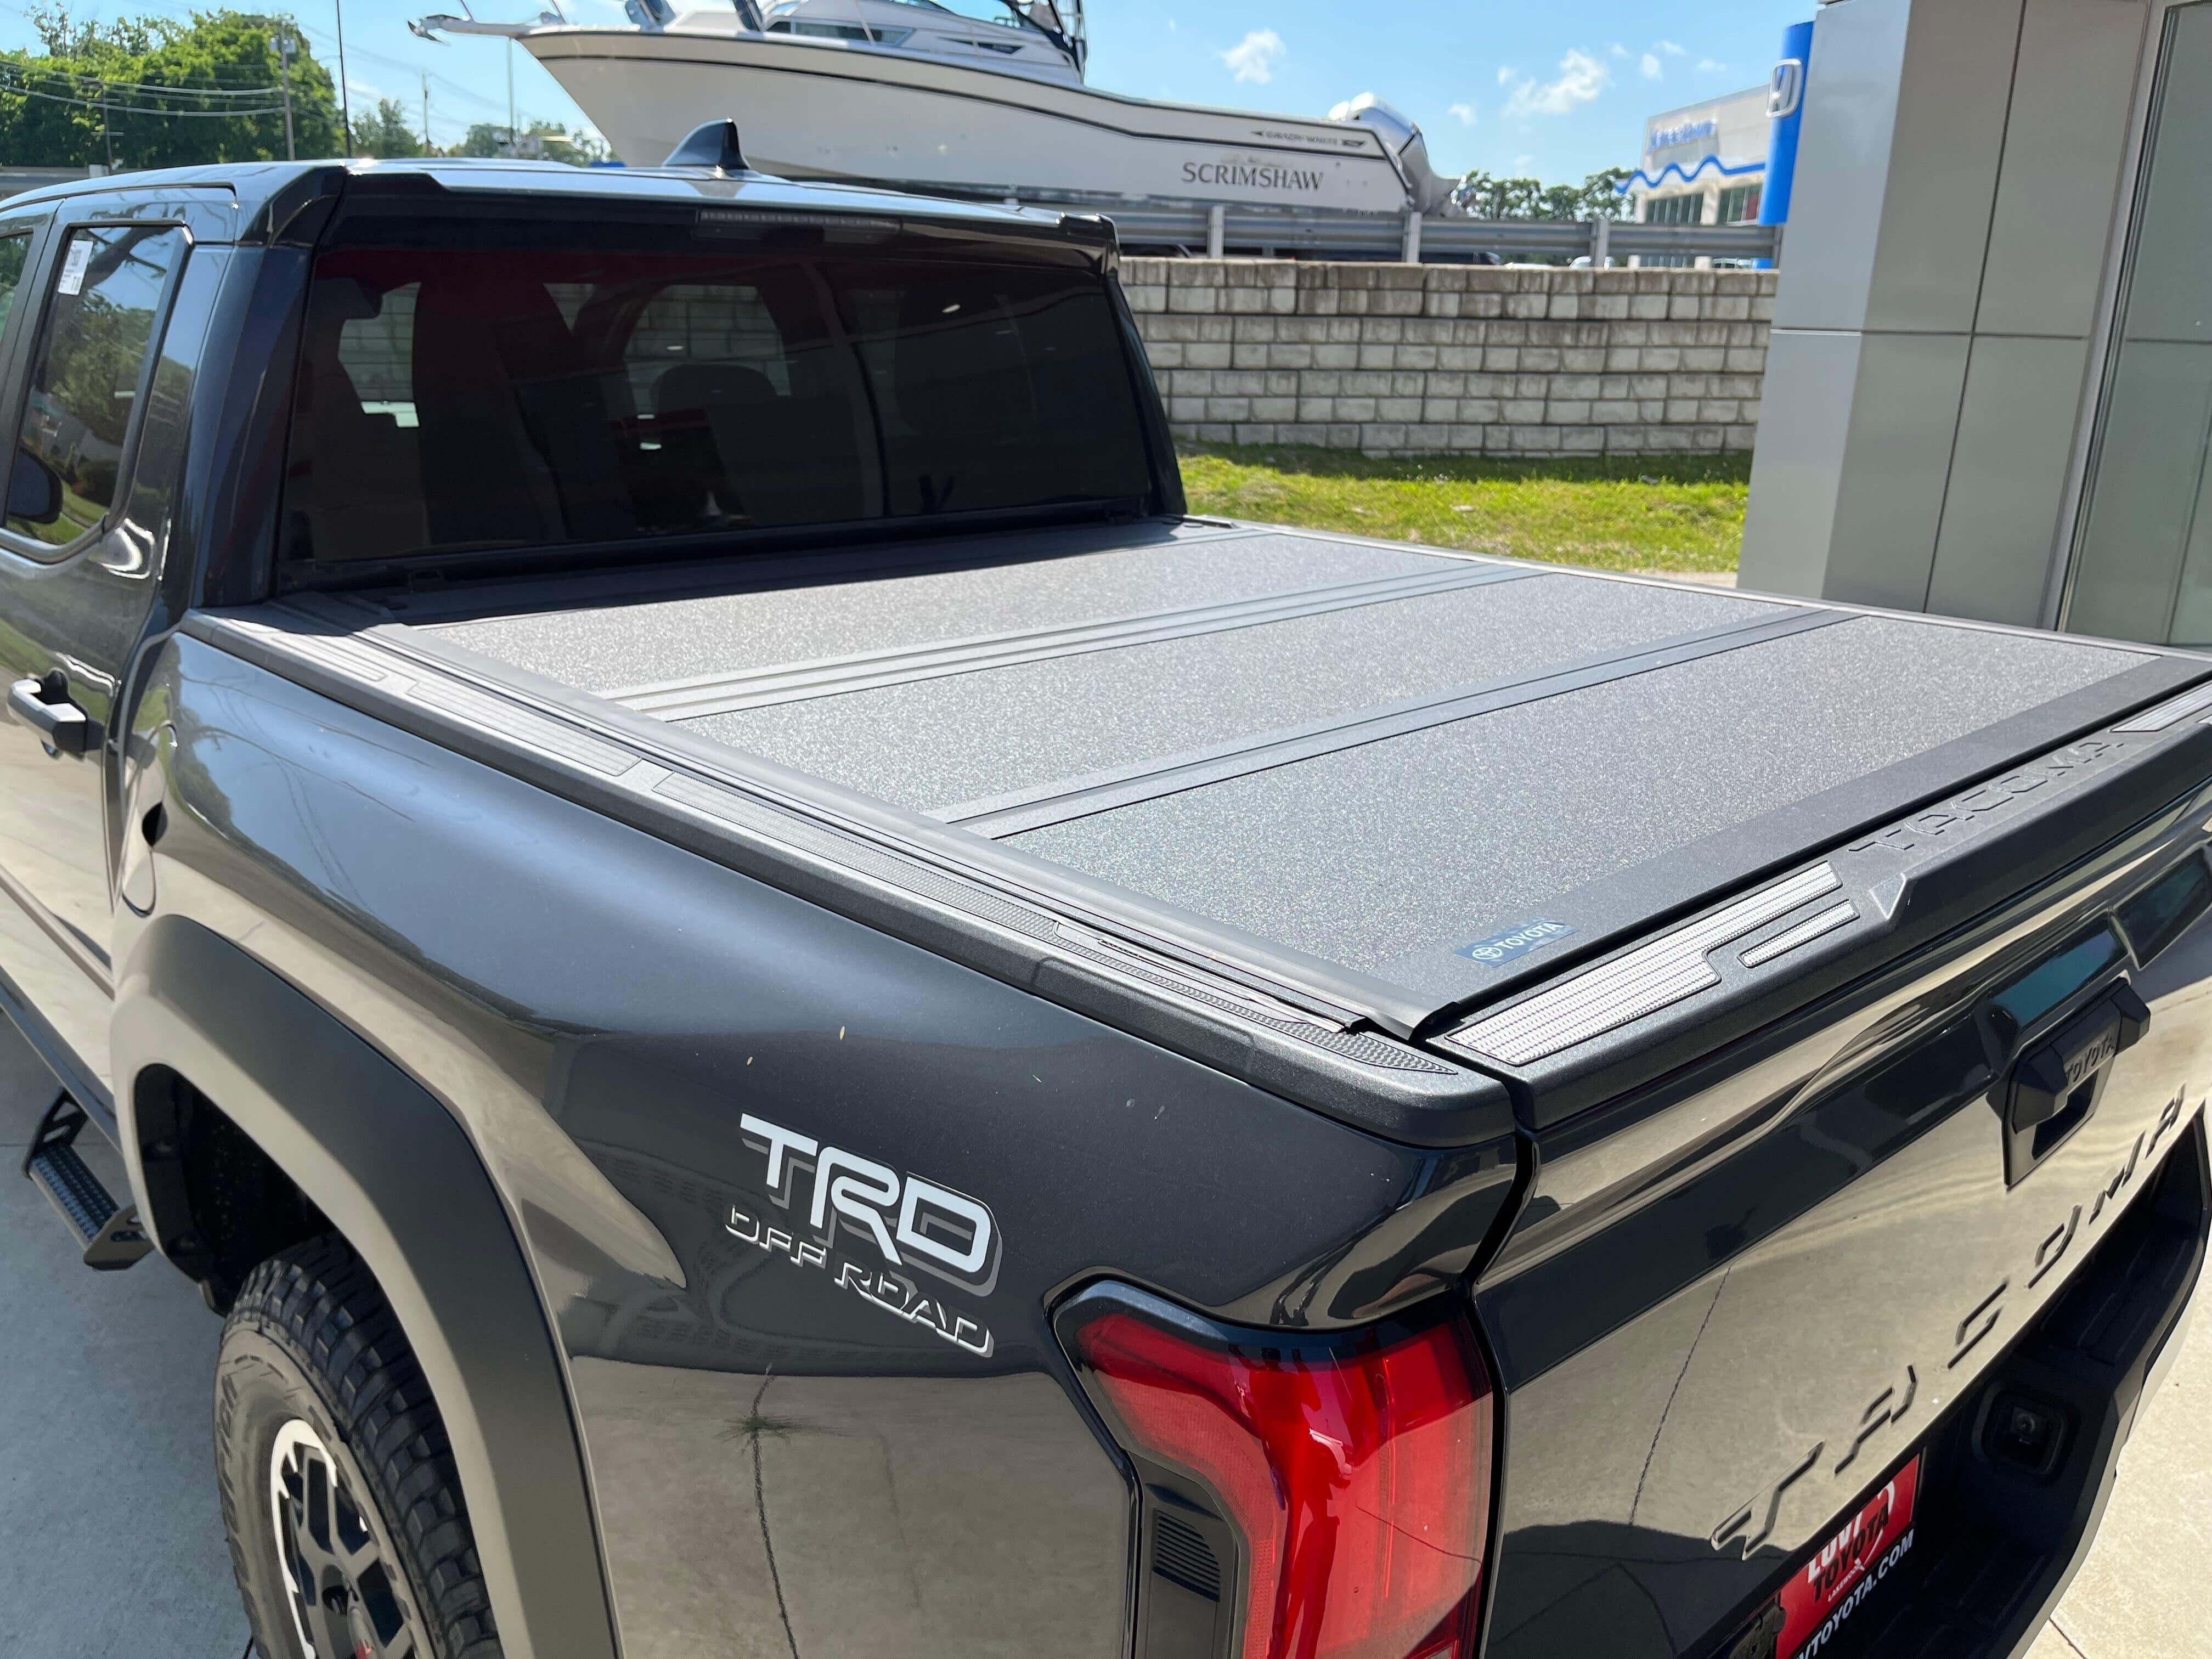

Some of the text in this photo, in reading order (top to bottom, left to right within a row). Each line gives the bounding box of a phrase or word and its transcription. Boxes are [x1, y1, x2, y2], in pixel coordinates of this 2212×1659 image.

[1181, 162, 1324, 190] SCRIMSHAW
[1847, 741, 2125, 851] TACOMA
[1493, 922, 1564, 950] TOYOTA
[2064, 1033, 2117, 1082] TOYOTA
[740, 1112, 992, 1274] TRD
[724, 1205, 995, 1358] OFF ROAD
[1711, 1082, 2187, 1560] TACOMA
[1814, 1502, 1889, 1602] TOYOTA
